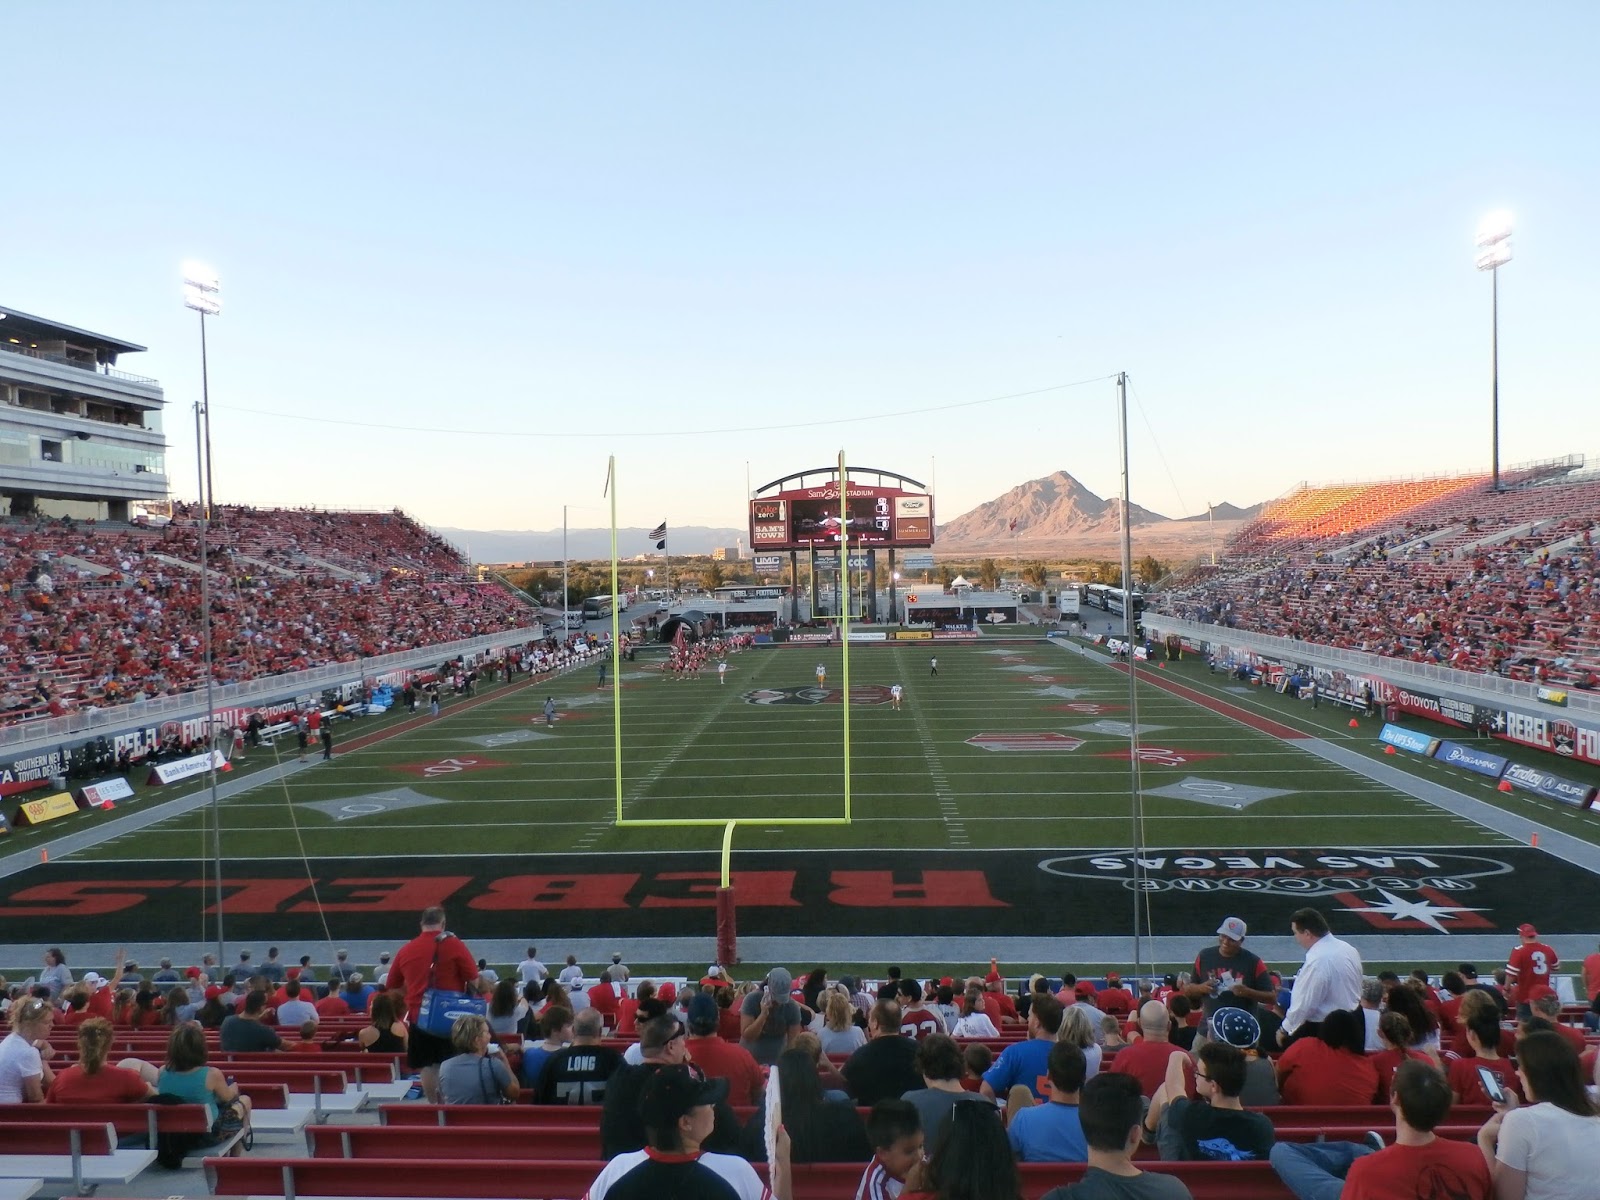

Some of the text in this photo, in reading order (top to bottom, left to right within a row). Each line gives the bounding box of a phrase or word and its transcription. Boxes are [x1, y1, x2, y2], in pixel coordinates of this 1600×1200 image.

[808, 490, 823, 498] Sam
[755, 505, 778, 514] Coke
[755, 557, 780, 565] UMC
[268, 702, 296, 717] TOYOTA
[1409, 695, 1440, 712] TOYOTA
[1384, 730, 1395, 742] The
[1506, 711, 1600, 761] REBEL FO
[14, 749, 72, 773] SOUTHERN NEVDA
[164, 767, 180, 777] Bank
[185, 760, 208, 772] America
[18, 767, 42, 783] TOYOTA
[1506, 764, 1543, 786] Findlay
[1555, 783, 1584, 797] ACURA
[1089, 854, 1441, 870] LAS VEGAS
[0, 868, 1012, 917] REBELS
[1138, 878, 1464, 891] WELCOME
[1531, 951, 1548, 975] 3
[567, 1055, 596, 1072] LONG
